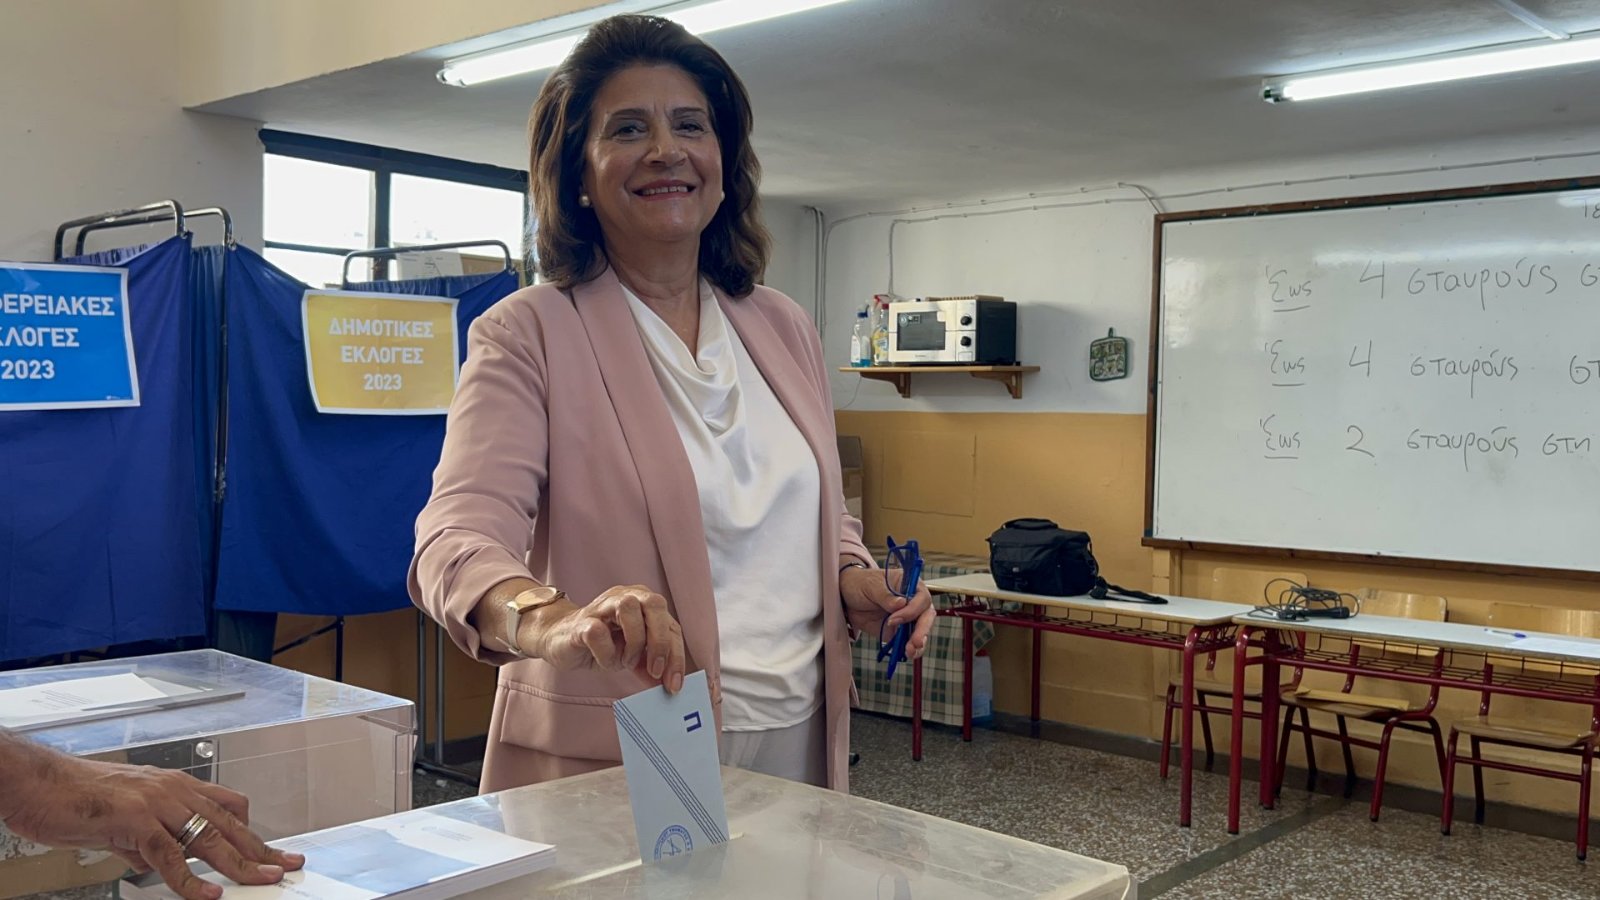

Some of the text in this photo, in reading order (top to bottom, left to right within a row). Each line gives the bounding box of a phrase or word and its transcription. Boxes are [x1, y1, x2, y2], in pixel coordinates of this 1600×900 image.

[1359, 259, 1386, 300] 4
[0, 326, 80, 347] ΛΟΓΕΣ
[328, 317, 434, 338] ΔΗΜΟΤΙΚΕΣ
[340, 345, 425, 365] ΕΚΛΟΓΕΣ
[1349, 340, 1373, 378] 4
[0, 359, 55, 380] 2023
[363, 373, 402, 391] 2023
[1345, 425, 1375, 458] 2
